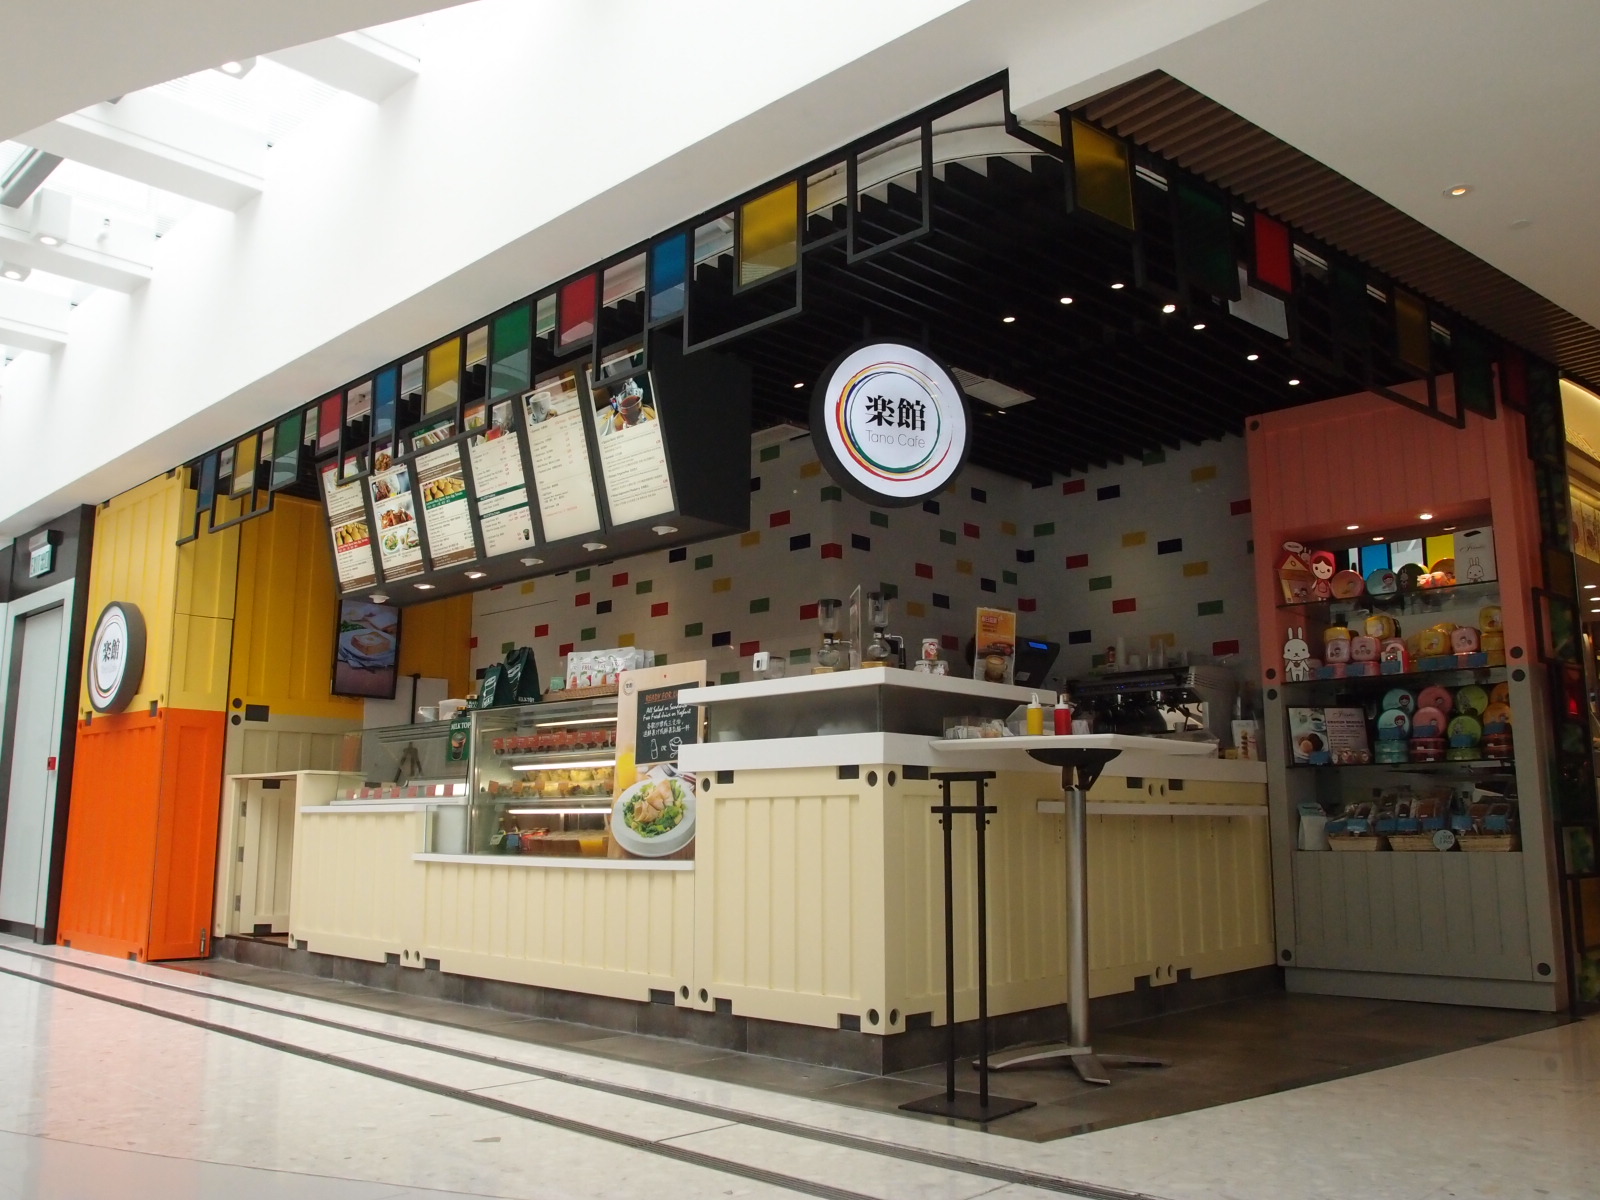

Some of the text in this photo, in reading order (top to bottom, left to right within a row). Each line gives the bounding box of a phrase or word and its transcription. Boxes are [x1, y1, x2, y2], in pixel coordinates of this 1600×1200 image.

[865, 395, 926, 431] 楽館
[866, 430, 926, 448] Tano Cafe
[461, 721, 472, 729] TOP
